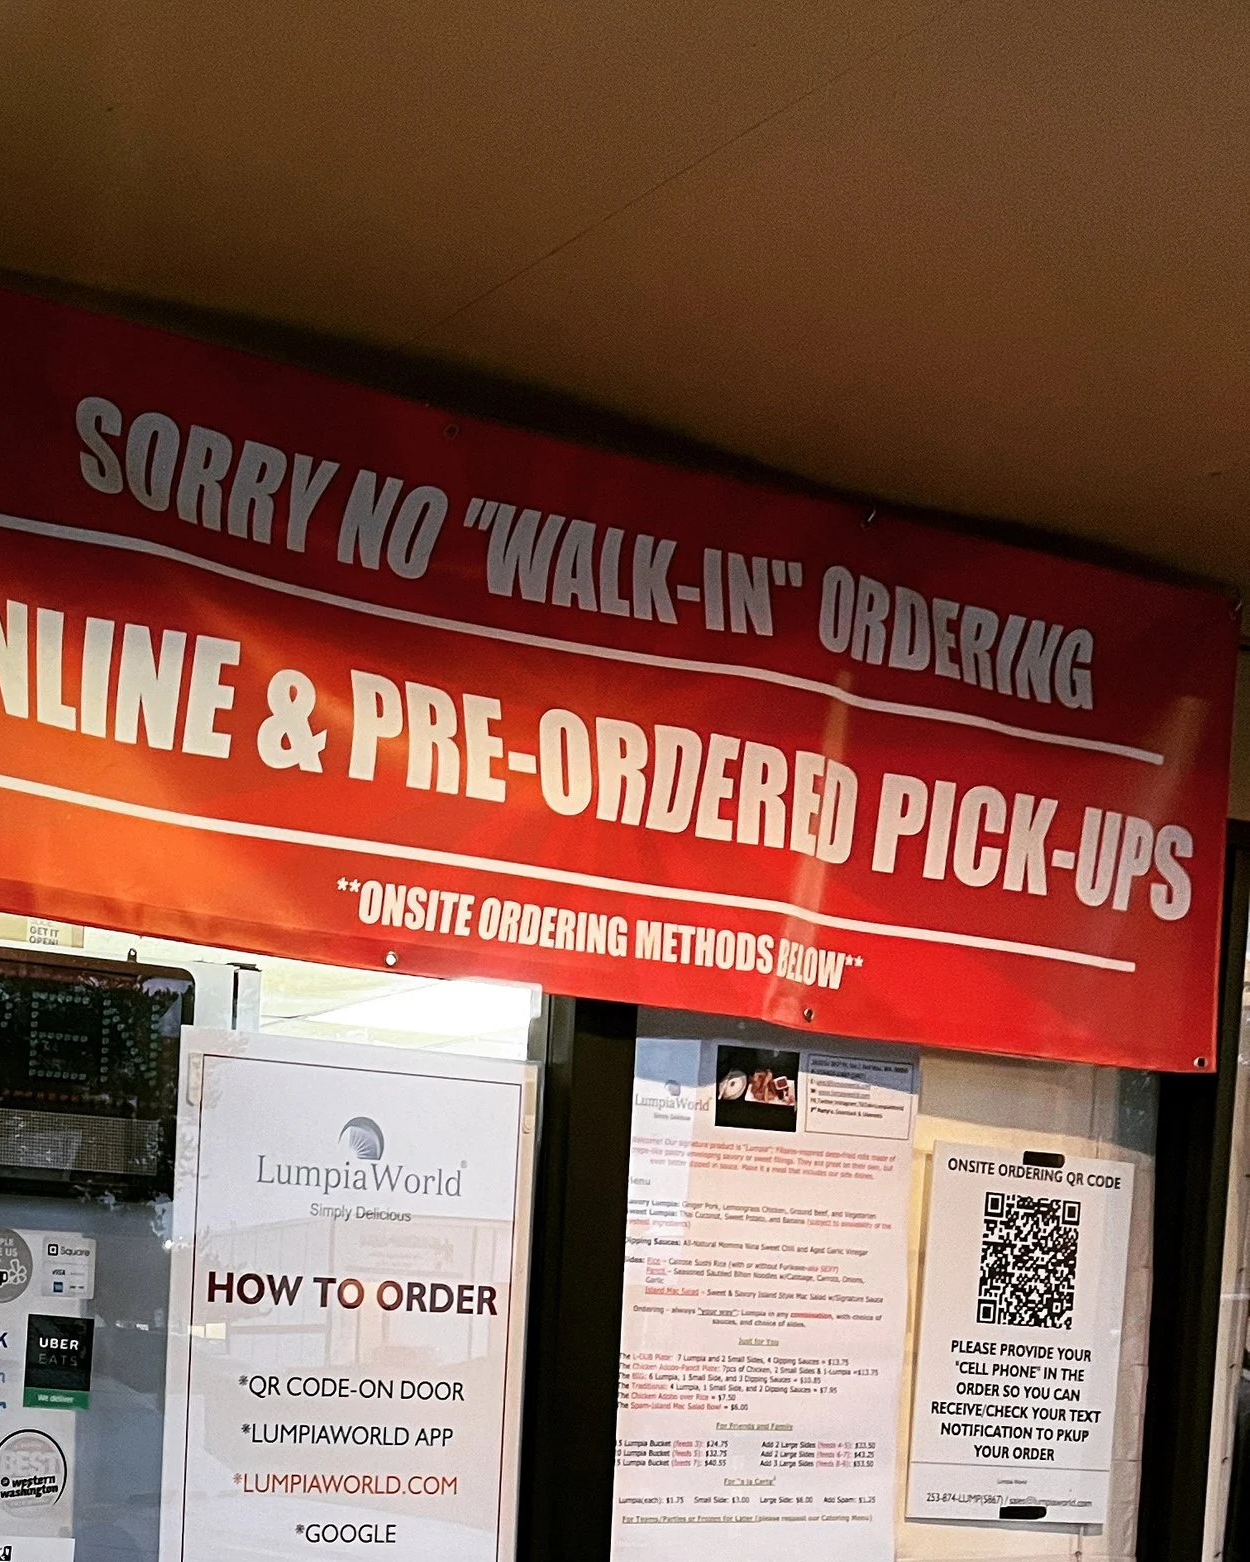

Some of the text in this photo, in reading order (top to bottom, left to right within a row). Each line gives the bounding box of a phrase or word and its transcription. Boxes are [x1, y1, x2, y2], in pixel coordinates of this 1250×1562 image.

[76, 396, 1094, 711] SORRY NO "WALK-IN" ORDERING
[257, 669, 327, 773] &
[349, 669, 858, 865] PRE-ORDERED
[871, 773, 1194, 921] PICK-UPS
[478, 897, 627, 958] ORDERING
[635, 920, 773, 975] METHODS
[948, 1158, 1121, 1190] ONSITE ORDERING QR CODE
[310, 1203, 412, 1223] Simply Delicious
[5, 1247, 18, 1256] US
[60, 1246, 90, 1257] Square
[208, 1271, 498, 1316] HOW TO ORDER
[39, 1337, 79, 1350] UBER
[951, 1340, 1092, 1363] PLEASE PROVIDE YOUR
[38, 1354, 78, 1367] EATS
[683, 1354, 706, 1362] Lumpia
[955, 1360, 1085, 1382] "CELL PHONE" IN THE
[287, 1377, 394, 1400] CODE-ON
[400, 1380, 465, 1402] DOOR
[956, 1382, 1081, 1402] ORDER SO YOU CAN
[931, 1401, 1101, 1424] RECEIVE/CHECK YOUR TEXT
[415, 1427, 454, 1447] APP
[940, 1422, 1089, 1443] NOTIFICATION TO PKUP
[624, 1440, 648, 1448] Lumpia
[974, 1445, 1055, 1462] YOUR ORDER
[0, 1484, 59, 1499] washington
[12, 1475, 56, 1488] western
